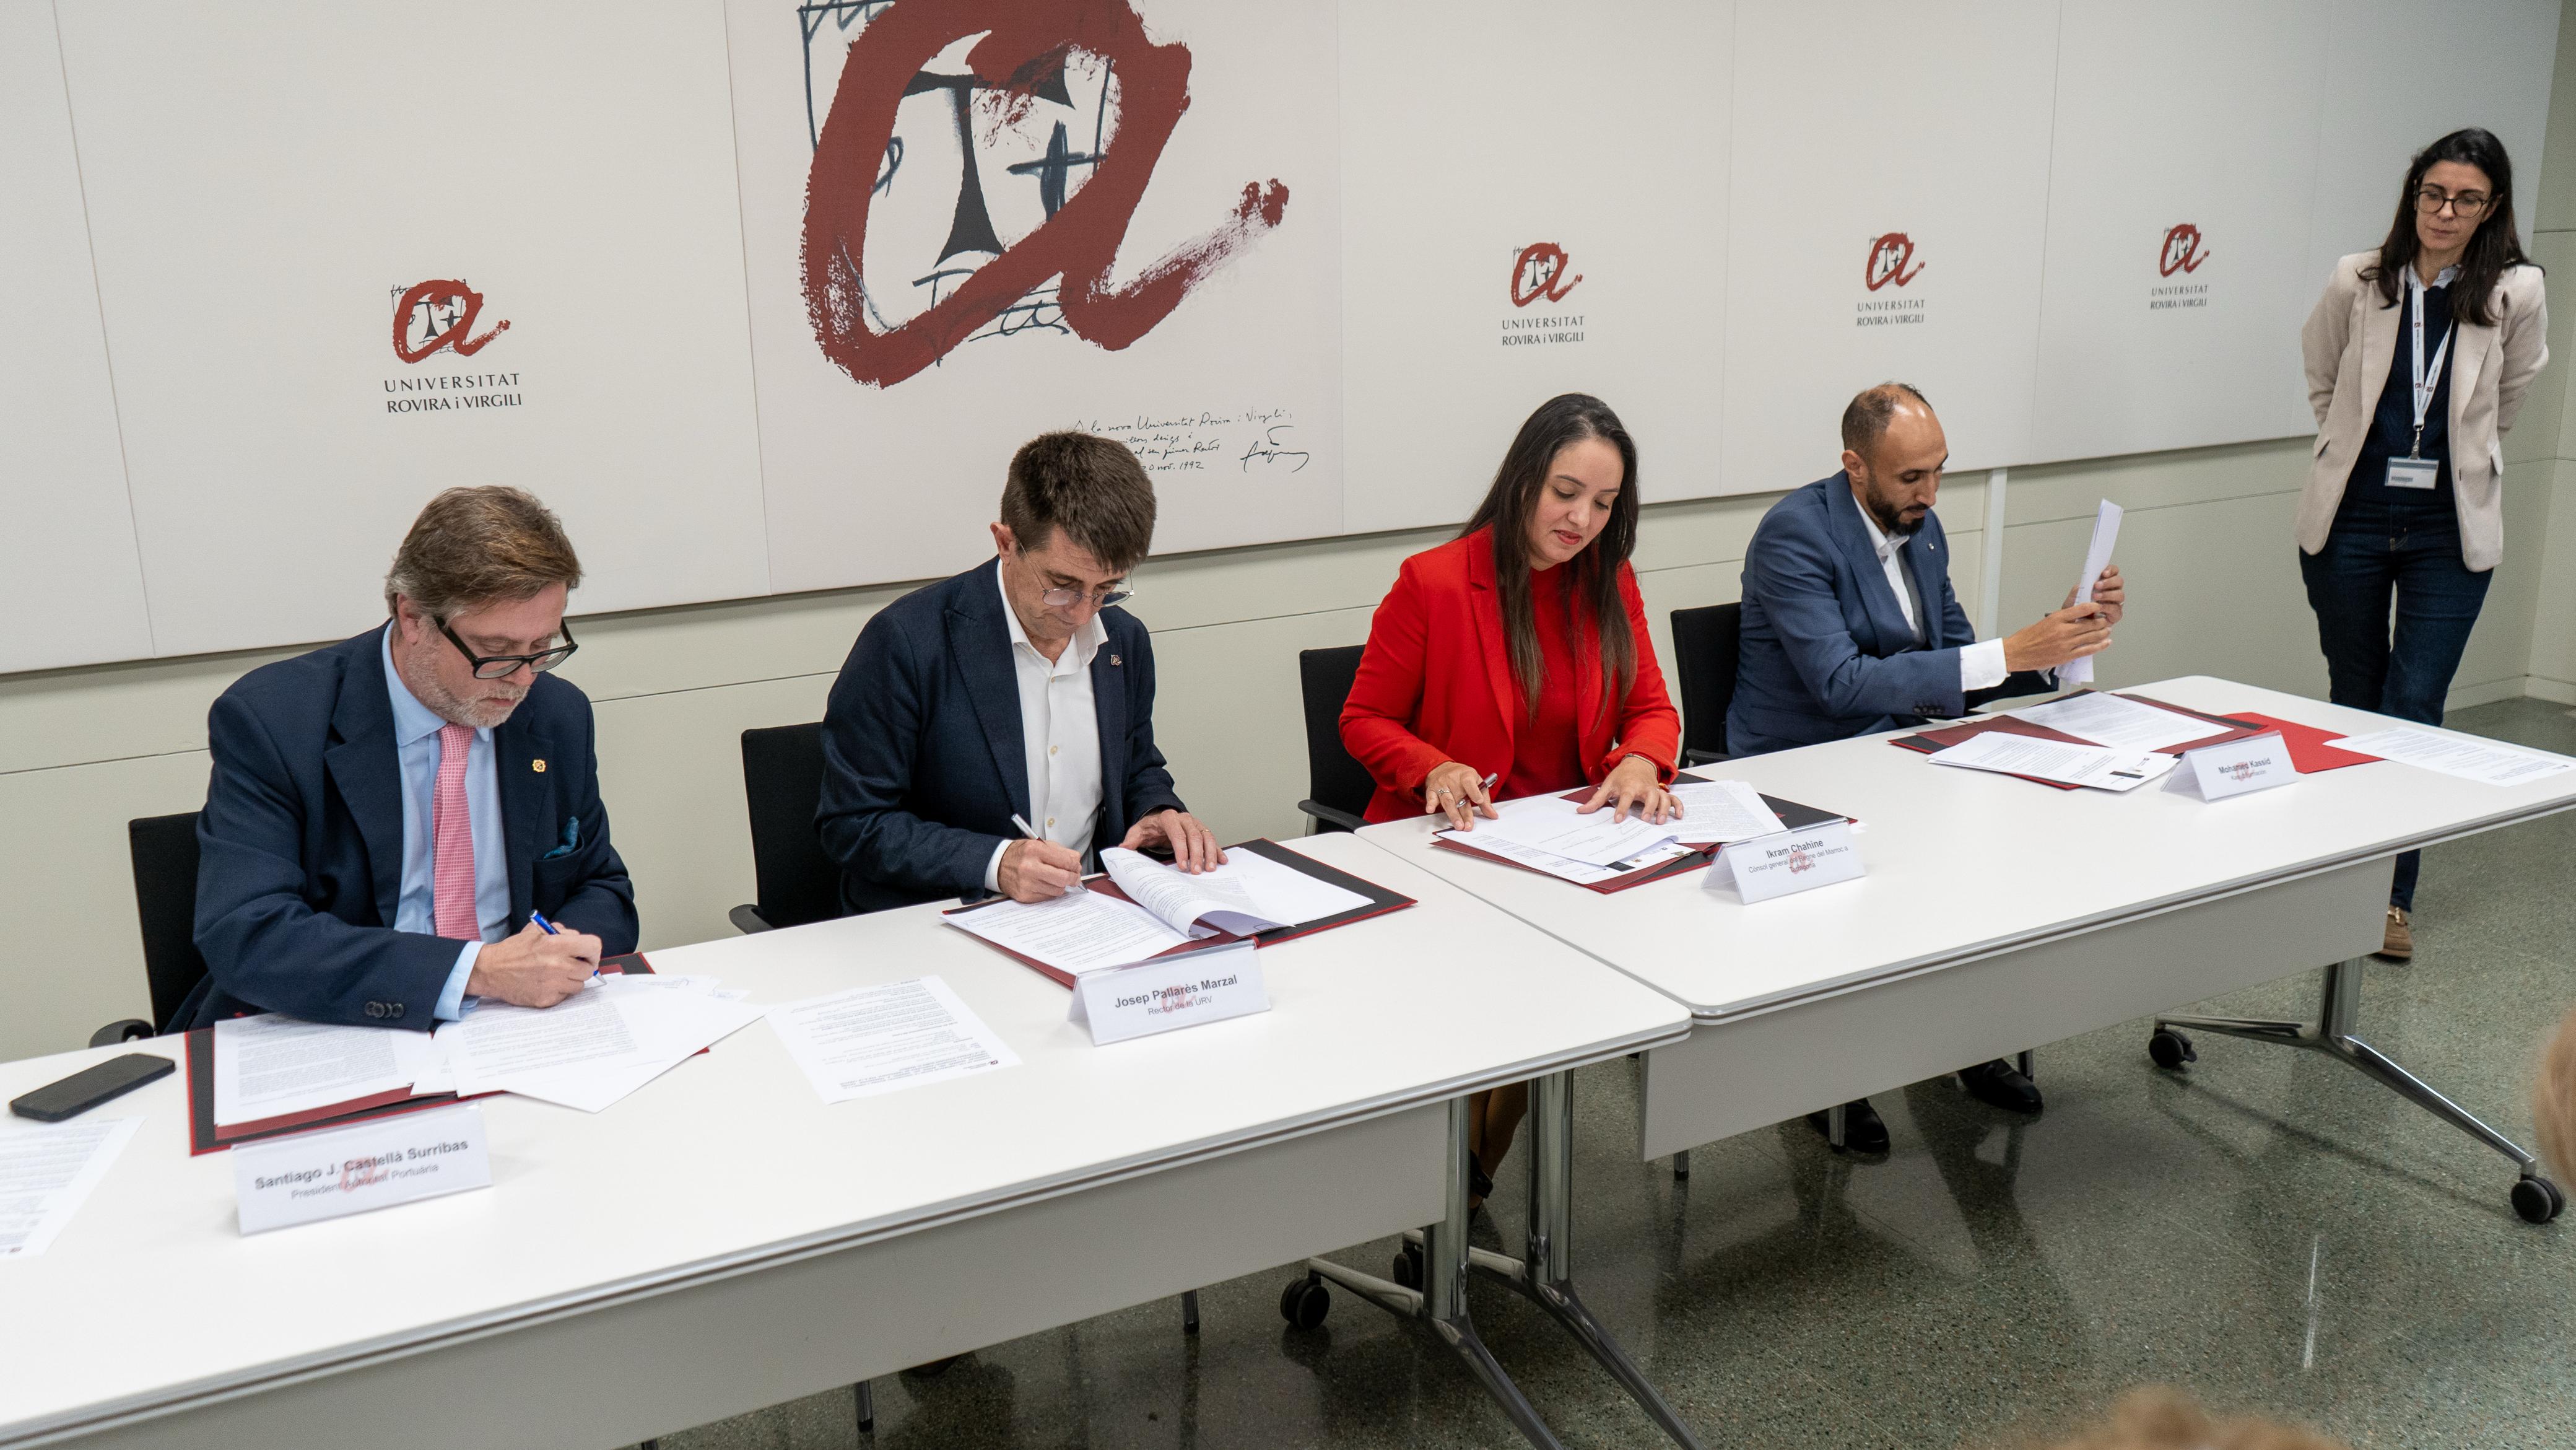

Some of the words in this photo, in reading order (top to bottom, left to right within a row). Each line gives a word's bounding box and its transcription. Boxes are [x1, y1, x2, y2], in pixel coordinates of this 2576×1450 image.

[2152, 285, 2208, 296] UNIVERSITAT
[1858, 299, 1925, 312] UNIVERSITAT
[2151, 300, 2177, 310] ROVIRA
[2182, 298, 2207, 308] VIRGILI
[1502, 316, 1585, 330] UNIVERSITAT
[1857, 317, 1888, 326] ROVIRA
[1895, 313, 1924, 324] VIRGILI
[1502, 334, 1540, 346] ROVIRA
[1543, 334, 1546, 344] i
[1549, 332, 1584, 343] VIRGILI
[385, 373, 520, 392] UNIVERSITAT
[387, 398, 451, 413] ROVIRA
[456, 397, 459, 409] i
[463, 393, 521, 408] VIRGILI
[1091, 420, 1101, 433] la
[1138, 416, 1195, 430] Universitat
[1199, 412, 1230, 427] Rovira
[1180, 461, 1204, 470] 1992
[2218, 762, 2249, 774] Mohamed
[1766, 846, 1790, 859] Ikram
[1791, 839, 1824, 854] Chahine
[1748, 863, 1769, 873] Cònsol
[1769, 859, 1789, 871] general
[1817, 850, 1825, 858] del
[1825, 847, 1844, 856] Marroc
[1115, 993, 1150, 1009] Josep
[1152, 984, 1198, 1000] Pallarès
[1201, 974, 1238, 991] Marzal
[1148, 1005, 1173, 1016] Rector
[1175, 1002, 1185, 1010] de
[1186, 1000, 1194, 1008] la
[1195, 995, 1212, 1007] URV
[255, 1167, 322, 1190] Santiago
[326, 1163, 341, 1177] J.
[344, 1151, 402, 1172] Castellà
[407, 1138, 469, 1160] Surribas
